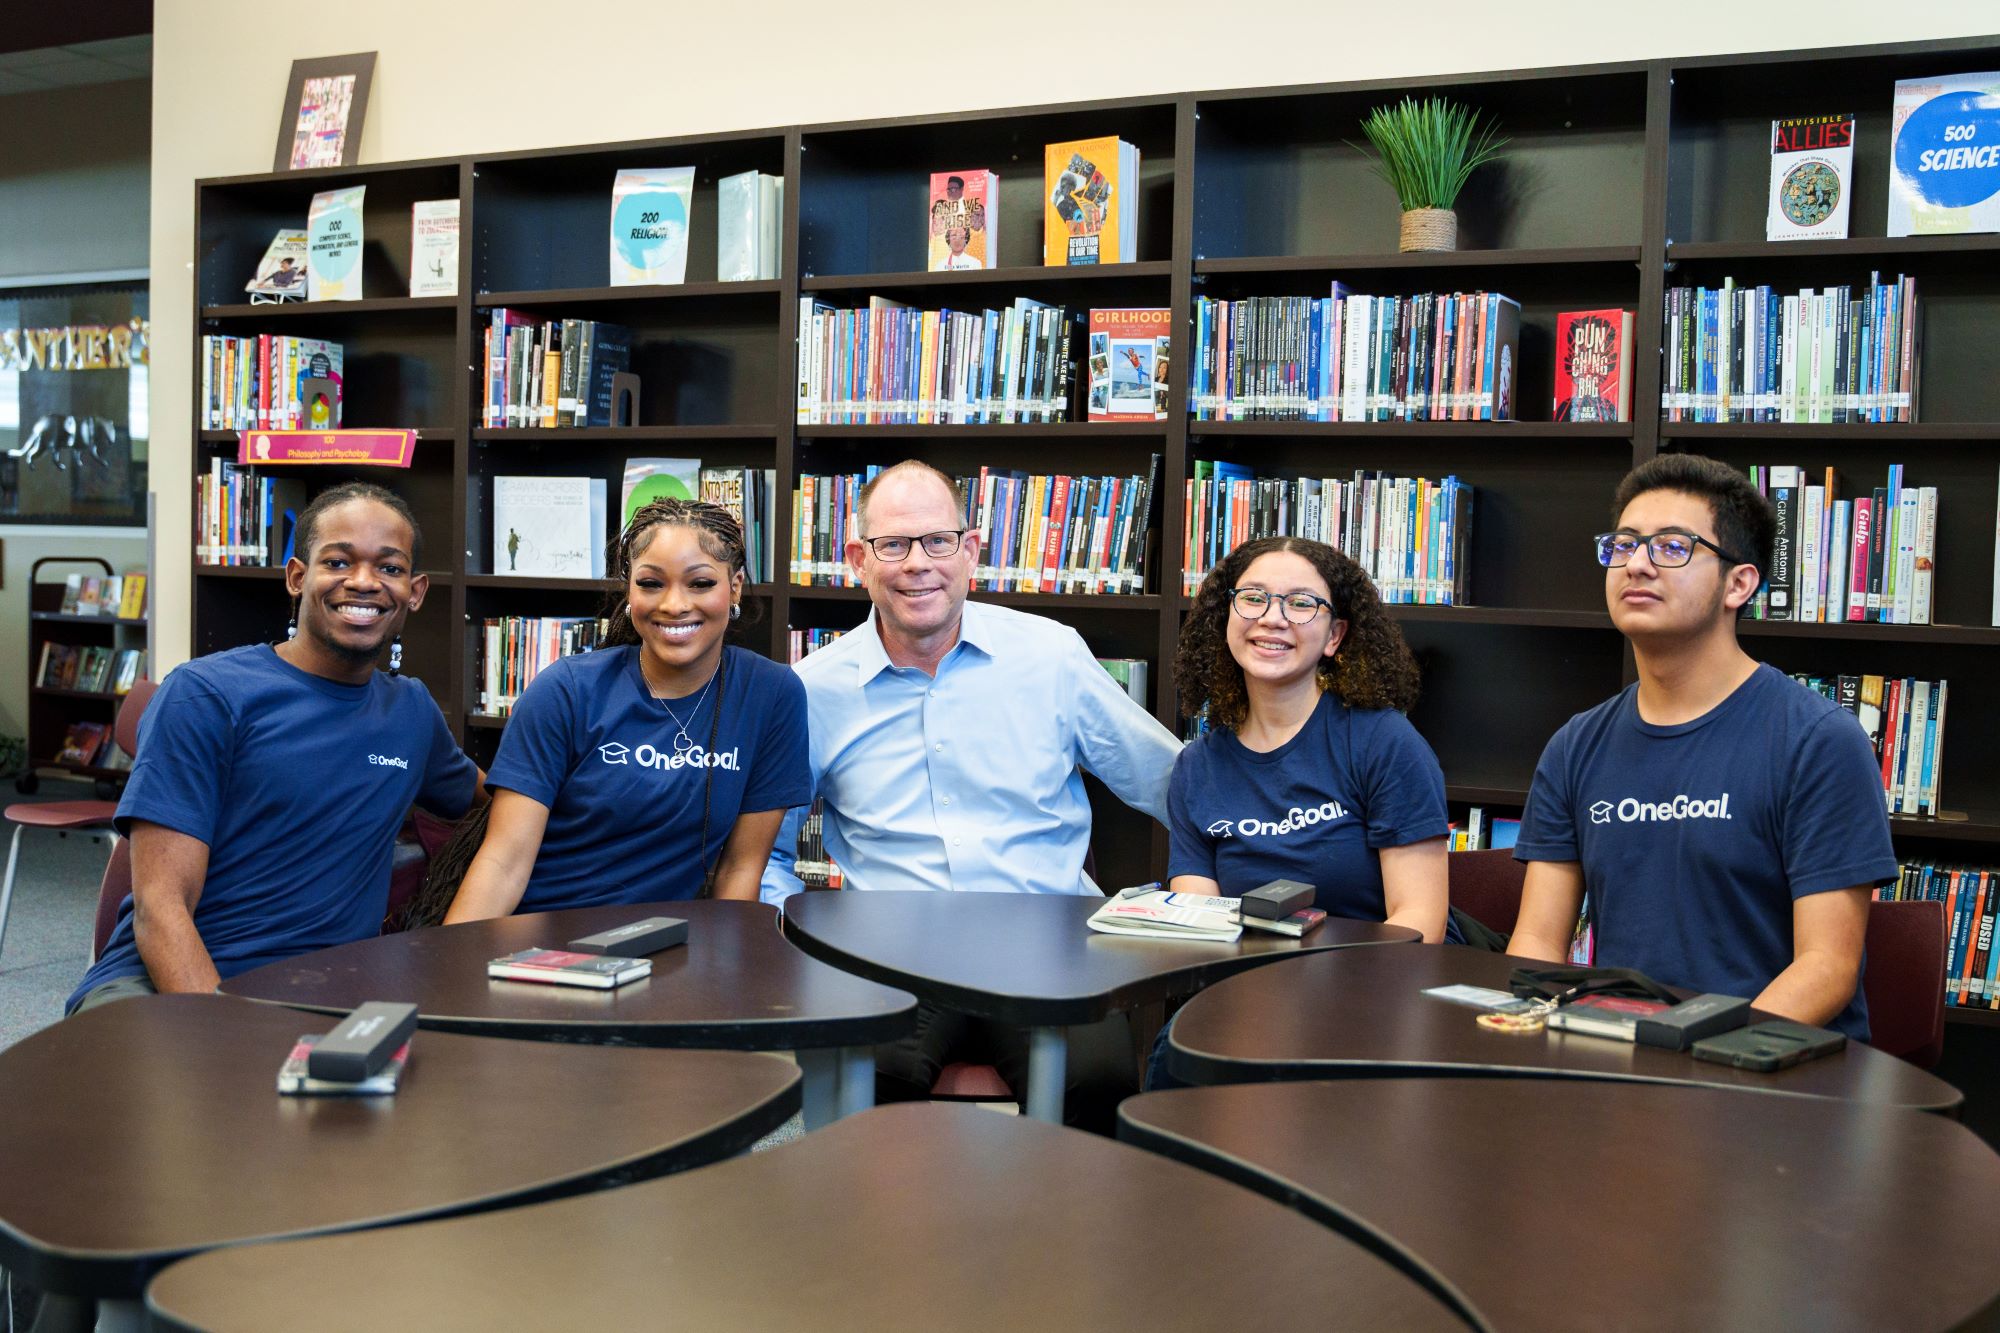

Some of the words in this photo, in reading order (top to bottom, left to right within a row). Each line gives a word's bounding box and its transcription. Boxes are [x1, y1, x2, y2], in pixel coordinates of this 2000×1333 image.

[1782, 115, 1842, 128] INVISIBLE
[1775, 120, 1853, 151] ALLIES
[1943, 124, 1976, 142] 500
[1918, 145, 2000, 172] SCIENCE
[935, 200, 959, 216] AND
[963, 197, 981, 211] WE
[641, 211, 660, 224] 200
[943, 213, 971, 229] RISE
[630, 227, 668, 240] RELIGION
[1069, 236, 1099, 248] REVOLUTION
[1094, 312, 1171, 323] GIRLHOOD
[1060, 375, 1067, 385] ME
[1578, 375, 1599, 399] BAG
[323, 436, 336, 444] 100
[287, 449, 321, 459] Philosophy
[334, 449, 370, 459] Psychology
[722, 480, 740, 499] THE
[1055, 481, 1064, 505] RULE
[1777, 501, 1787, 535] GRAY'S
[1855, 508, 1869, 548] Gulp.
[1049, 531, 1058, 555] RUIN
[1925, 535, 1933, 554] Flesh
[1778, 537, 1789, 582] Anatomy
[1841, 682, 1856, 708] SPIL
[378, 755, 409, 770] OneGoal
[635, 745, 741, 771] OneGoal.
[1617, 793, 1731, 823] OneGoal.
[1237, 800, 1347, 838] OneGoal.
[1951, 912, 1961, 938] COCAINE
[1977, 915, 1994, 951] DOSED
[1947, 950, 1956, 971] CRACK
